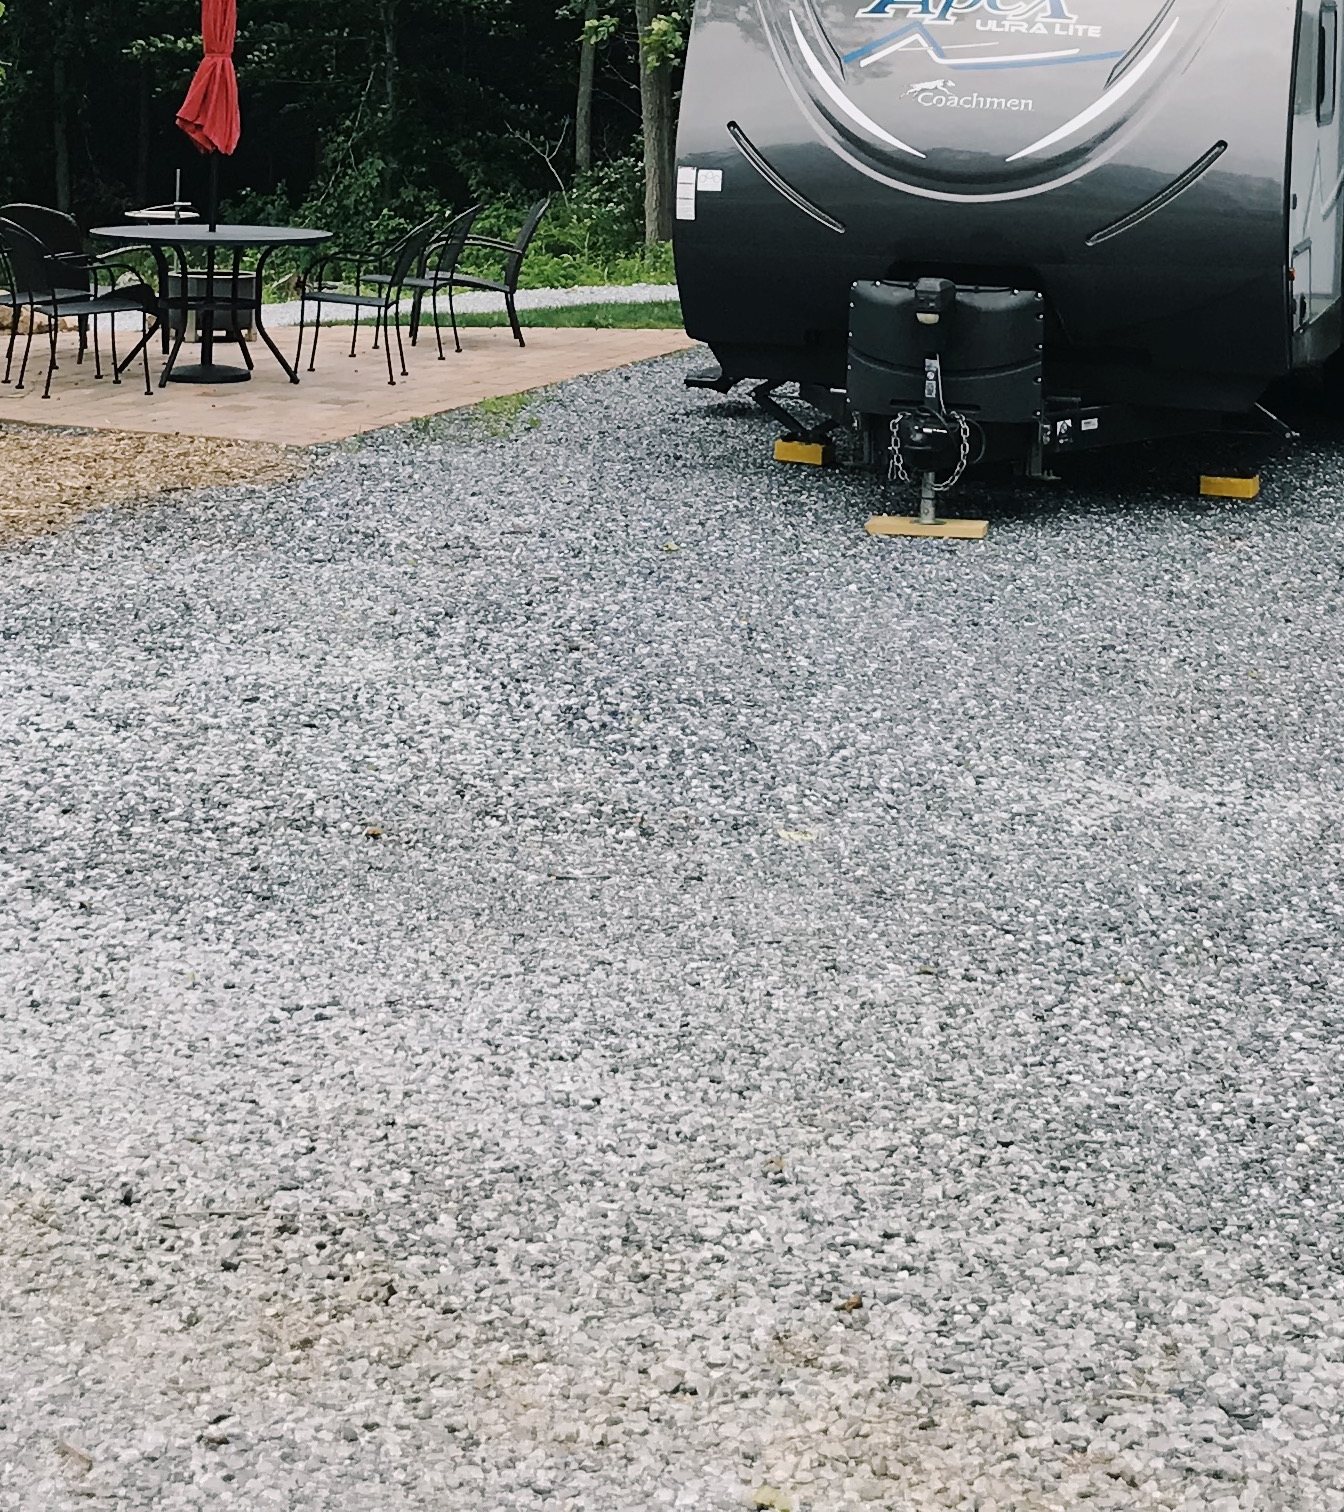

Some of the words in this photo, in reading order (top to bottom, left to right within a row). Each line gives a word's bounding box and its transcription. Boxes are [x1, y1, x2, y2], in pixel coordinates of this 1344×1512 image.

[975, 19, 1049, 35] ULTRA
[1054, 22, 1102, 38] LITE
[917, 91, 1034, 112] Coachmen
